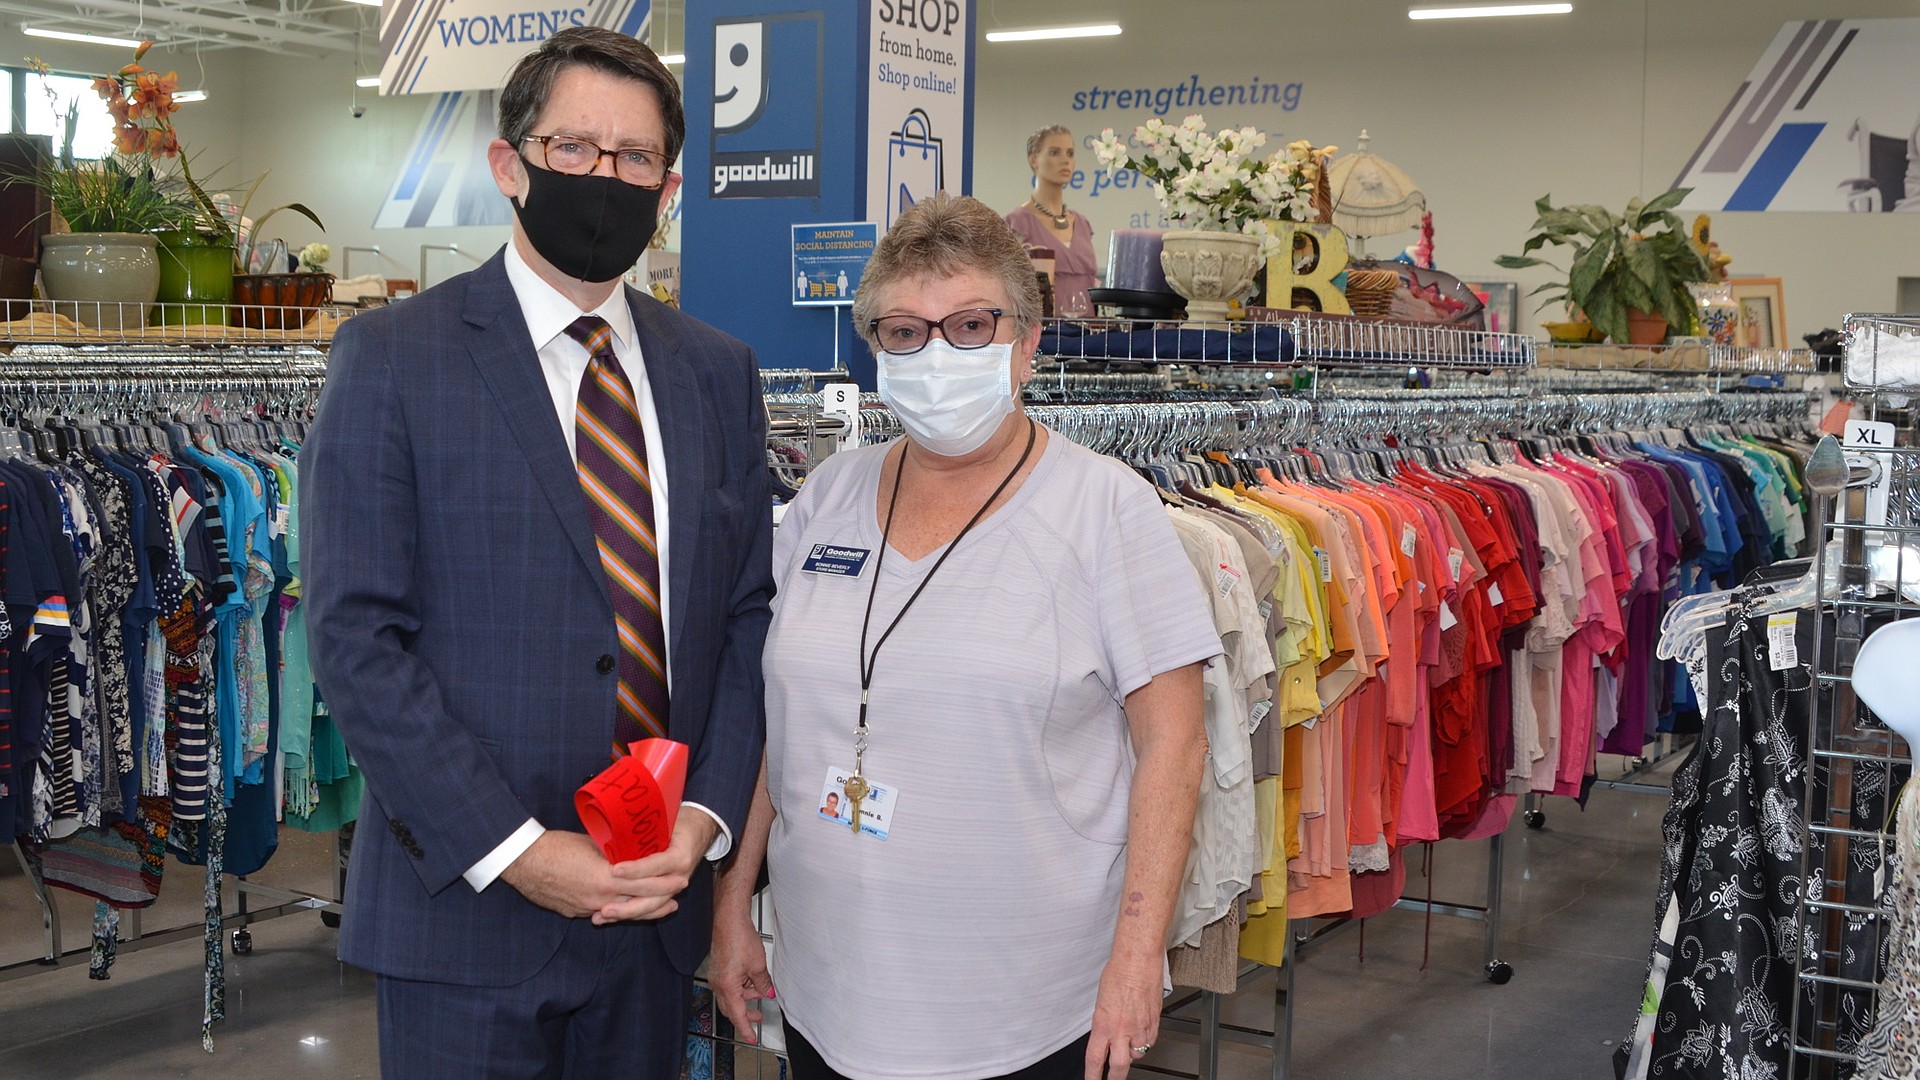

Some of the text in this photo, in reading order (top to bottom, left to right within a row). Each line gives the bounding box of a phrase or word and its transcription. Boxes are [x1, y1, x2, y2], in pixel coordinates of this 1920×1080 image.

[879, 0, 960, 36] SHOP
[880, 31, 957, 66] from home.
[878, 63, 957, 94] Shop online!
[1072, 75, 1303, 115] strengthening
[714, 154, 813, 194] goodwill
[815, 230, 854, 239] MAINTAIN
[795, 240, 874, 250] SOCIAL DISTANCING
[650, 267, 674, 281] MORE
[836, 390, 845, 403] S
[1856, 427, 1881, 445] XL
[826, 548, 865, 558] Goodwill
